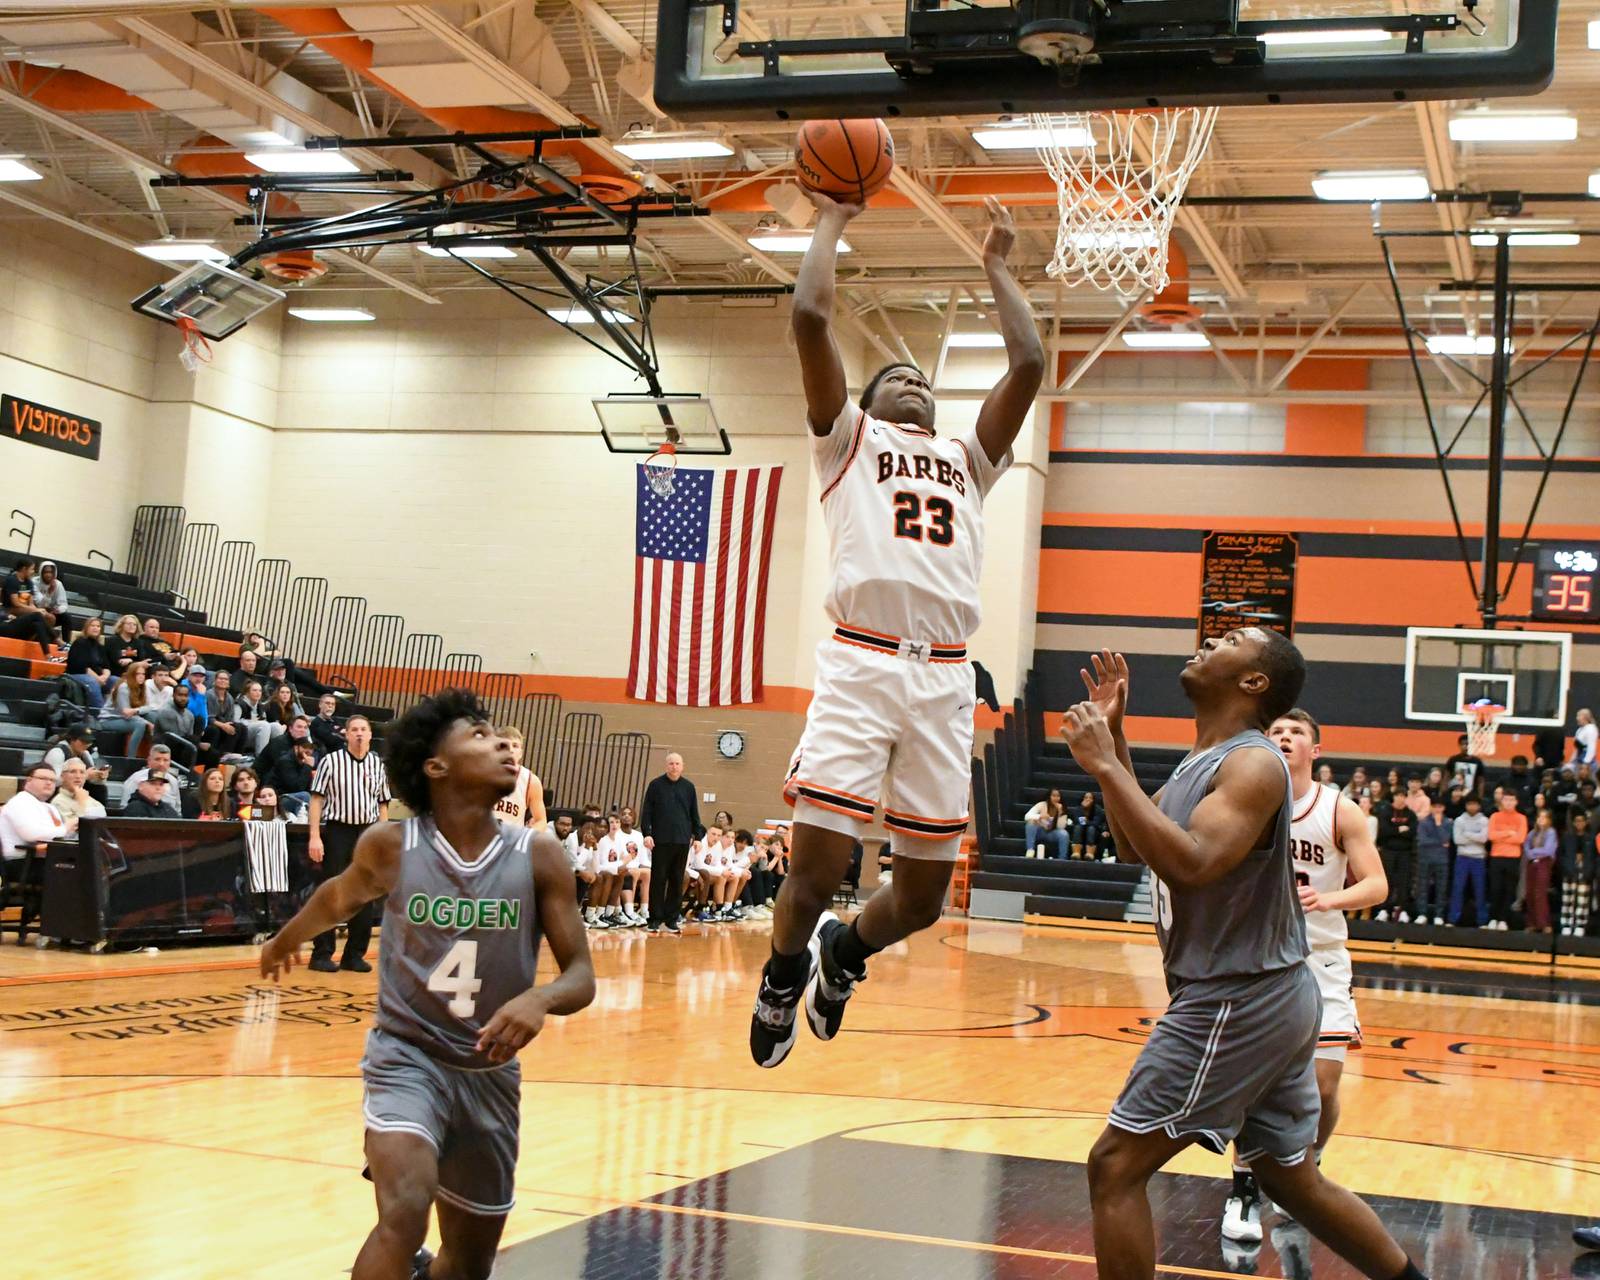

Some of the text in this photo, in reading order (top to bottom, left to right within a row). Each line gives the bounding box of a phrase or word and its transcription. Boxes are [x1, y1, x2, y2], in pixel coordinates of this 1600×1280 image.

[12, 401, 92, 446] VISITORS
[877, 451, 966, 498] BARBS
[893, 490, 955, 547] 23
[1546, 574, 1592, 613] 35
[496, 800, 520, 817] RBS
[1290, 838, 1324, 866] RBS
[407, 893, 521, 930] OGDEN
[427, 940, 483, 1019] 4
